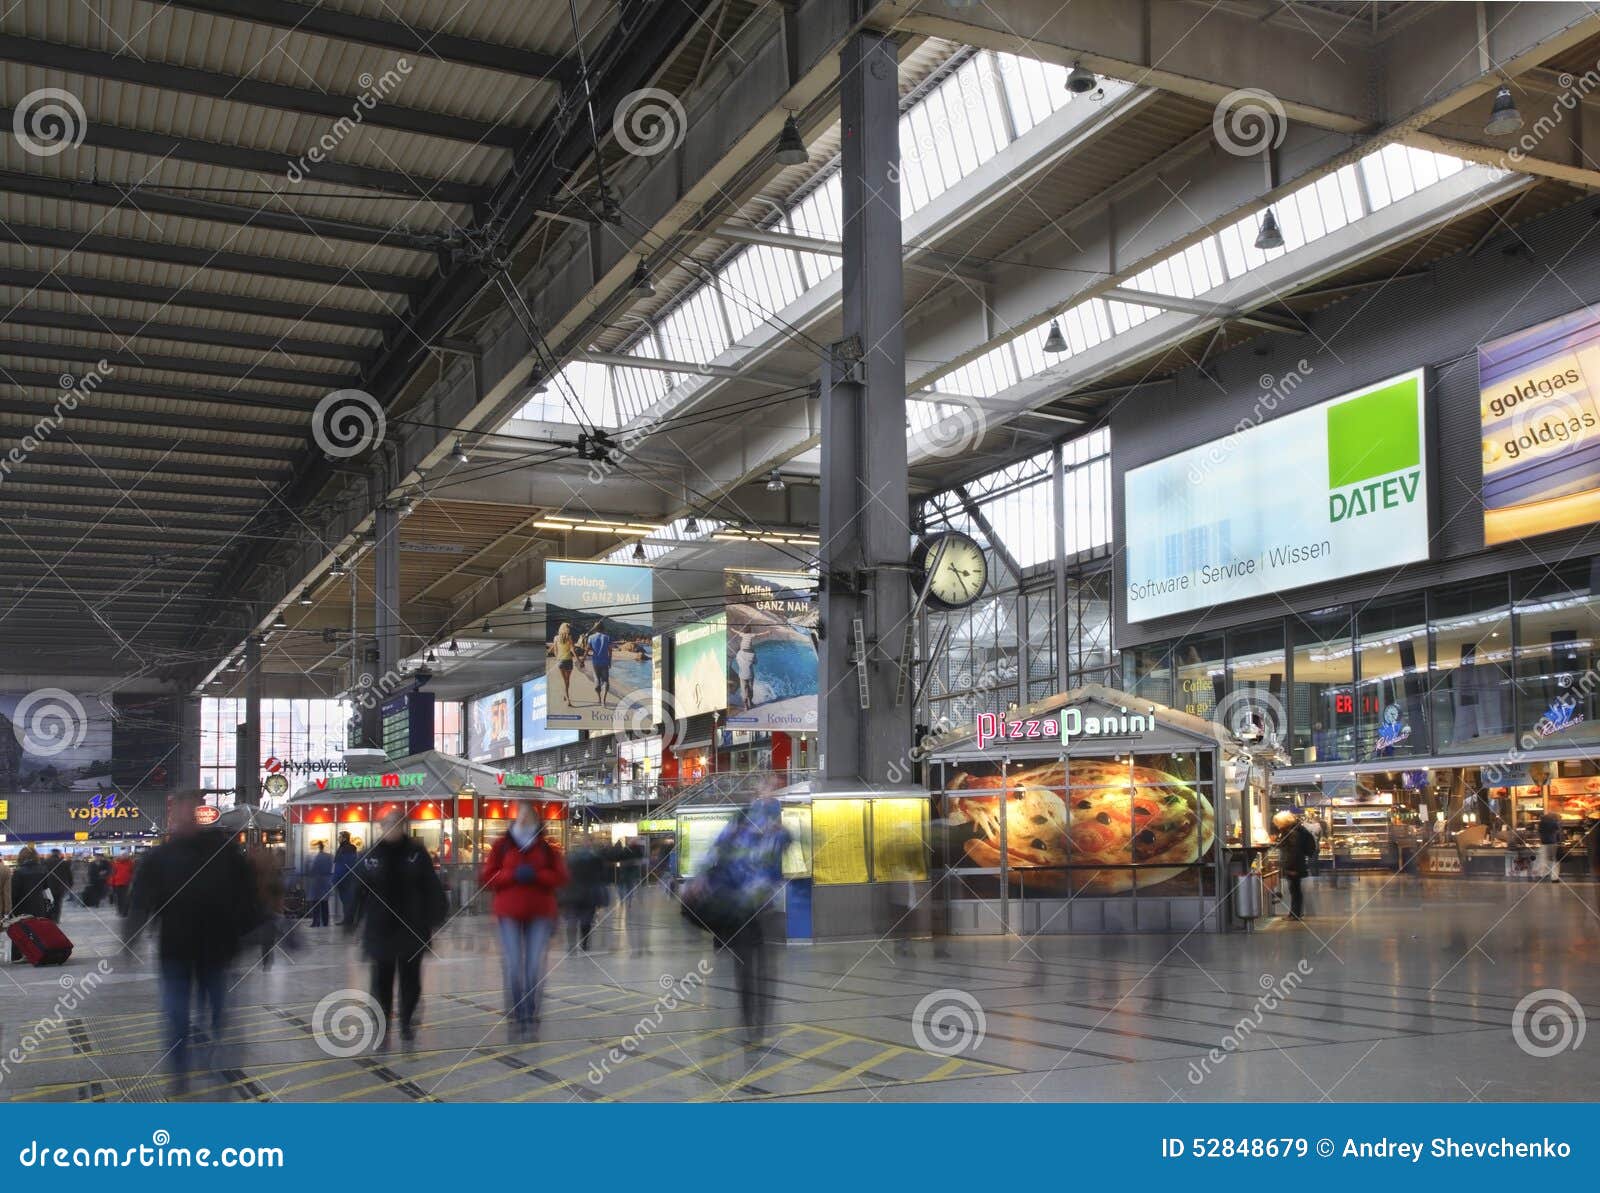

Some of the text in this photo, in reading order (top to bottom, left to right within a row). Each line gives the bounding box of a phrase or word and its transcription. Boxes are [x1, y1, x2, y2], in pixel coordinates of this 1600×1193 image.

[1490, 369, 1579, 417] goldgas
[1504, 413, 1596, 458] goldgas
[1329, 471, 1421, 523] DATEV
[1130, 540, 1331, 601] Software Service Wissen
[756, 601, 808, 611] GANZ NAH
[69, 807, 140, 820] YORMA'S
